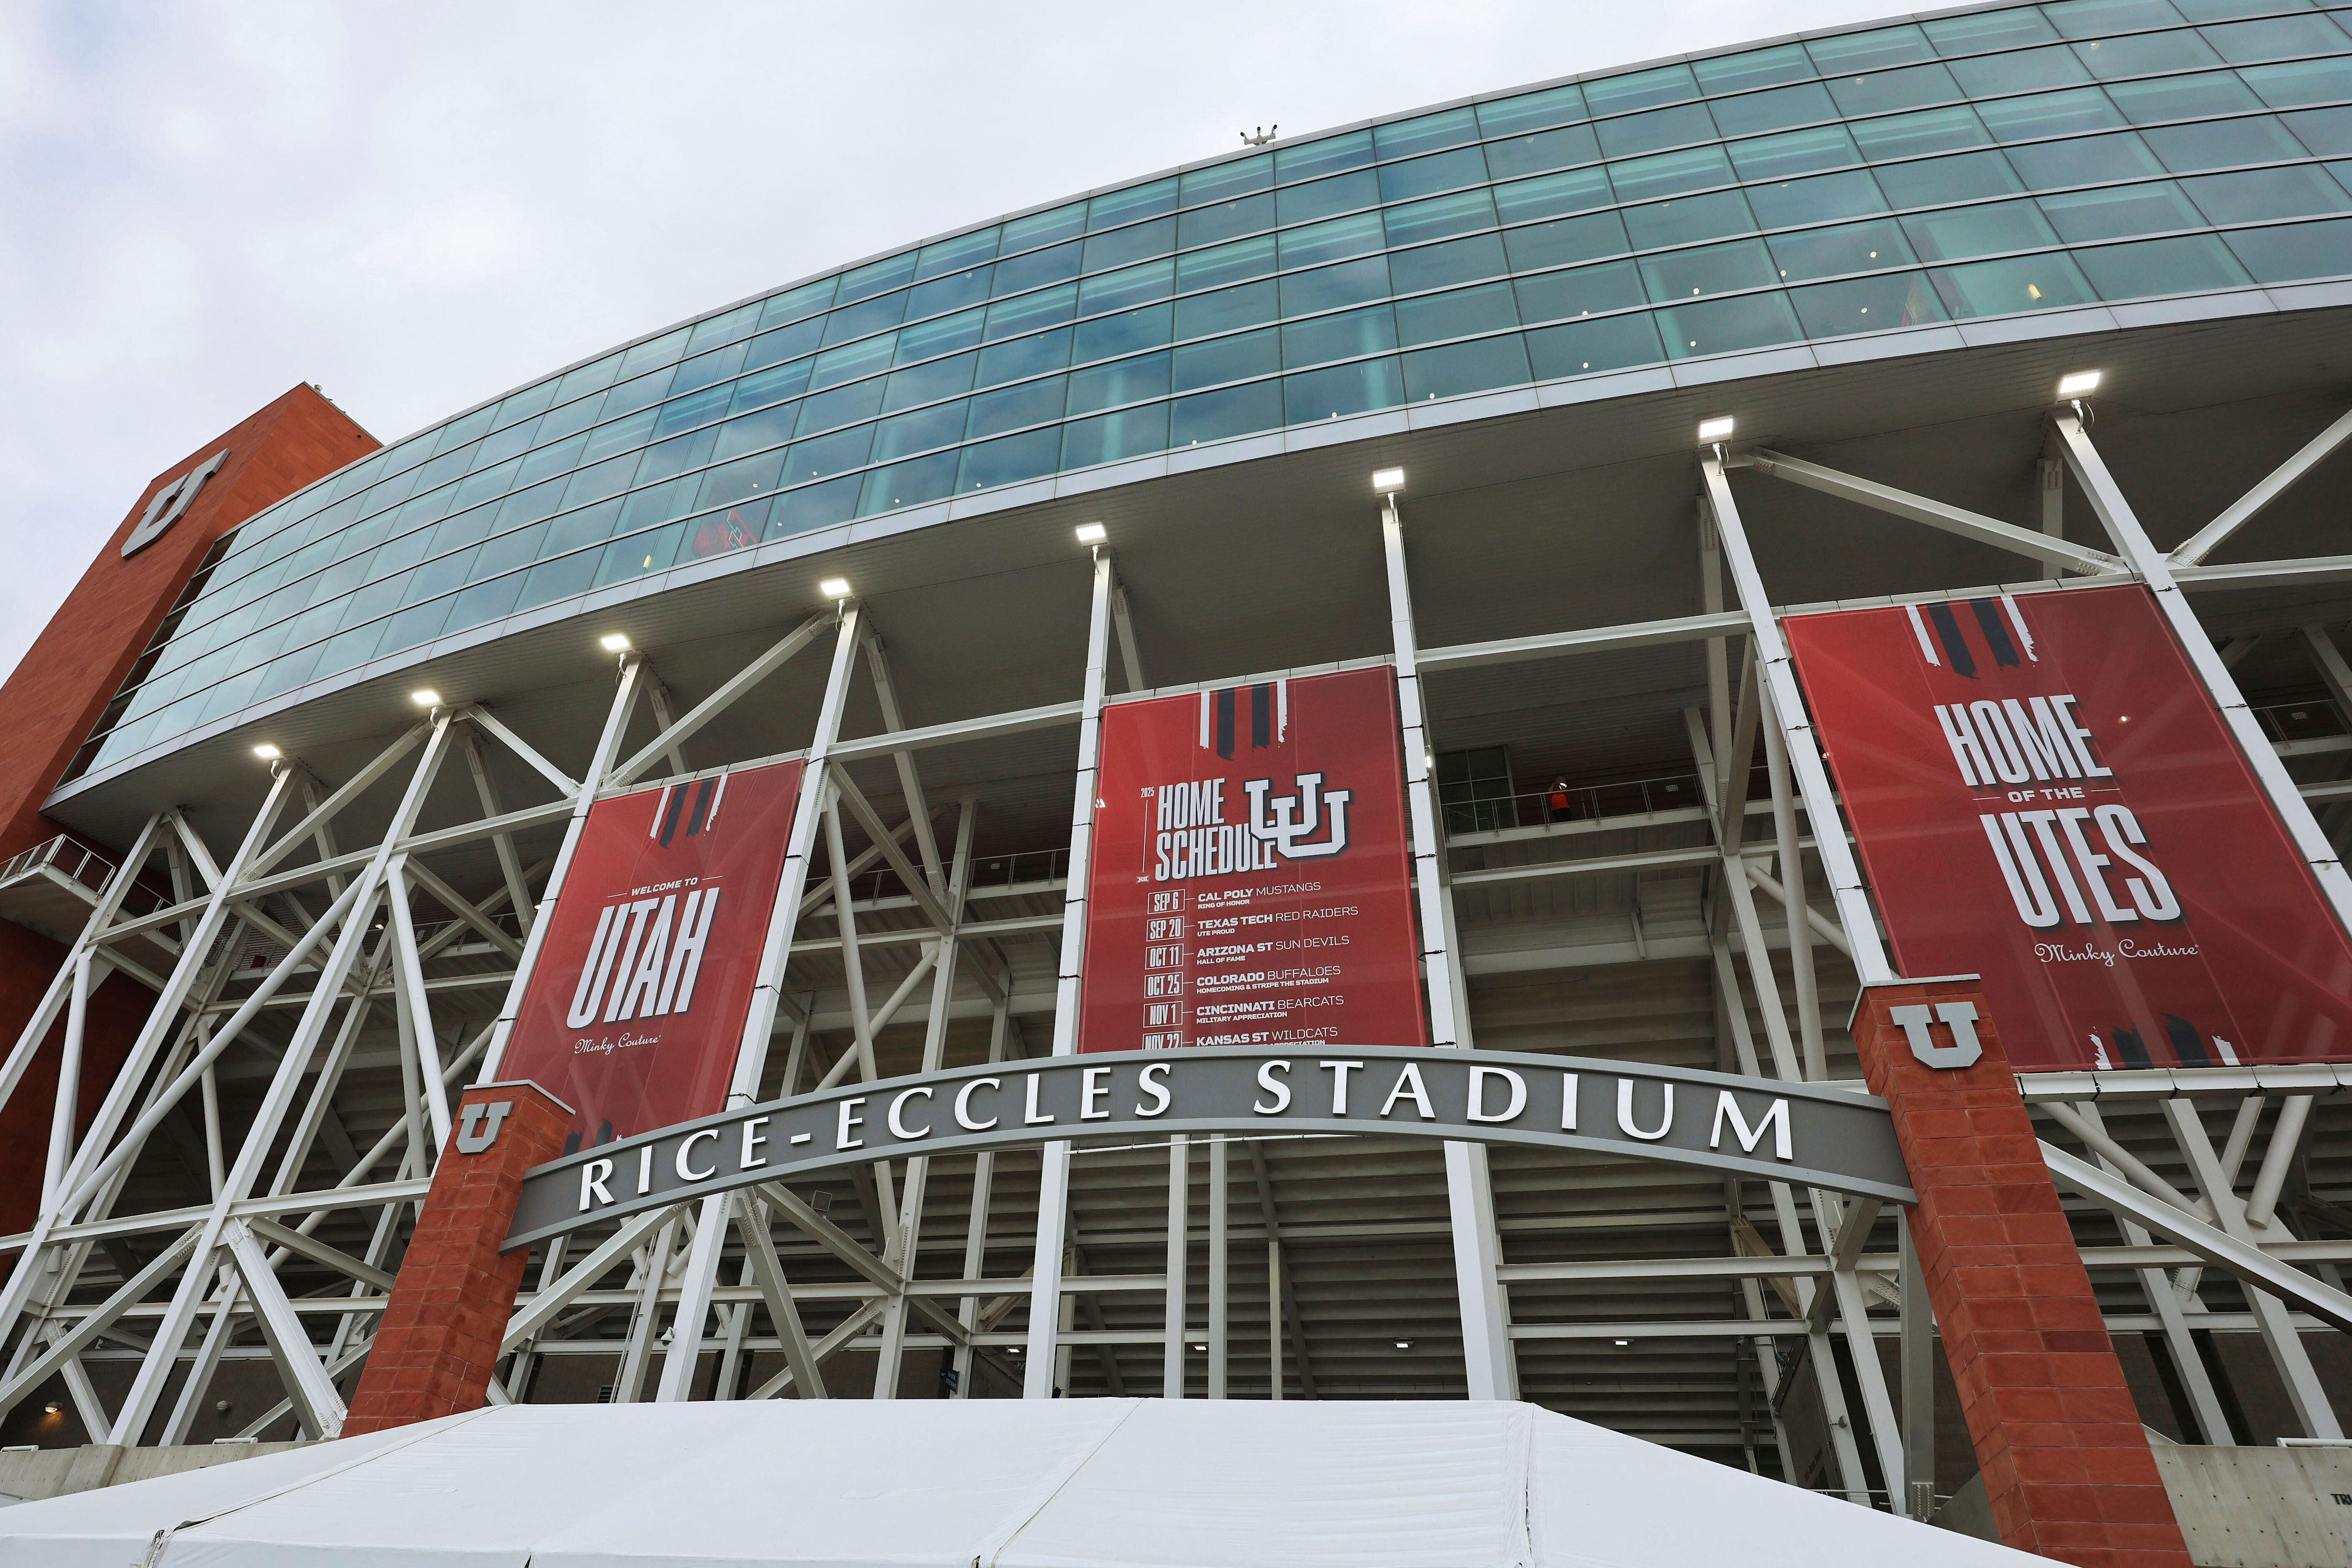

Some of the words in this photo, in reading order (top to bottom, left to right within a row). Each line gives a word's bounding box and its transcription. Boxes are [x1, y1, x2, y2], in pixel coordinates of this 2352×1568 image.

[1933, 694, 2113, 786] HOME
[1140, 787, 1154, 798] 2025
[2008, 790, 2035, 803] OF
[2039, 787, 2086, 800] THE
[1156, 778, 1225, 831] HOME
[1155, 820, 1277, 881] SCHEDULE
[1979, 805, 2181, 927] UTES
[631, 880, 682, 896] WELCOME
[684, 877, 698, 886] TO
[1198, 892, 1221, 902] CAL
[1224, 889, 1253, 899] POLY
[1256, 882, 1321, 896] MUSTANGS
[1154, 891, 1170, 912] SEP
[1172, 892, 1179, 910] 6
[1197, 918, 1238, 929] TEXAS
[1240, 914, 1273, 925] TECH
[1276, 911, 1300, 922] RED
[1303, 906, 1358, 919] RAIDERS
[1150, 919, 1166, 939] SEP
[1168, 918, 1181, 937] 20
[1150, 947, 1168, 967] OCT
[1169, 946, 1179, 965] 11
[1197, 943, 1255, 958] ARIZONA
[1257, 942, 1273, 951] ST
[1276, 940, 1301, 950] SUN
[1303, 936, 1350, 948] DEVILS
[2034, 943, 2115, 967] Minky
[566, 887, 720, 1029] UTAH
[1147, 975, 1165, 996] OCT
[1167, 974, 1180, 994] 25
[1197, 972, 1265, 986] COLORADO
[1267, 966, 1341, 980] BUFFALOES
[1196, 986, 1245, 994] HOMECOMING
[1149, 1004, 1169, 1026] NOV
[1171, 1004, 1176, 1023] 1
[1196, 1001, 1275, 1016] CINCINNATI
[1277, 995, 1344, 1009] BEARCATS
[1232, 1012, 1288, 1021] APPRECIATION
[1145, 1035, 1164, 1050] NOV
[1166, 1033, 1179, 1049] 22
[1196, 1033, 1250, 1046] KANSAS
[1251, 1032, 1269, 1042] ST
[1271, 1027, 1338, 1041] WILDCATS
[1889, 1001, 1983, 1069] U
[574, 1037, 615, 1055] Minky
[455, 1101, 513, 1154] U
[578, 1064, 1171, 1212] RICE-ECCLES
[1253, 1059, 1793, 1160] STADIUM
